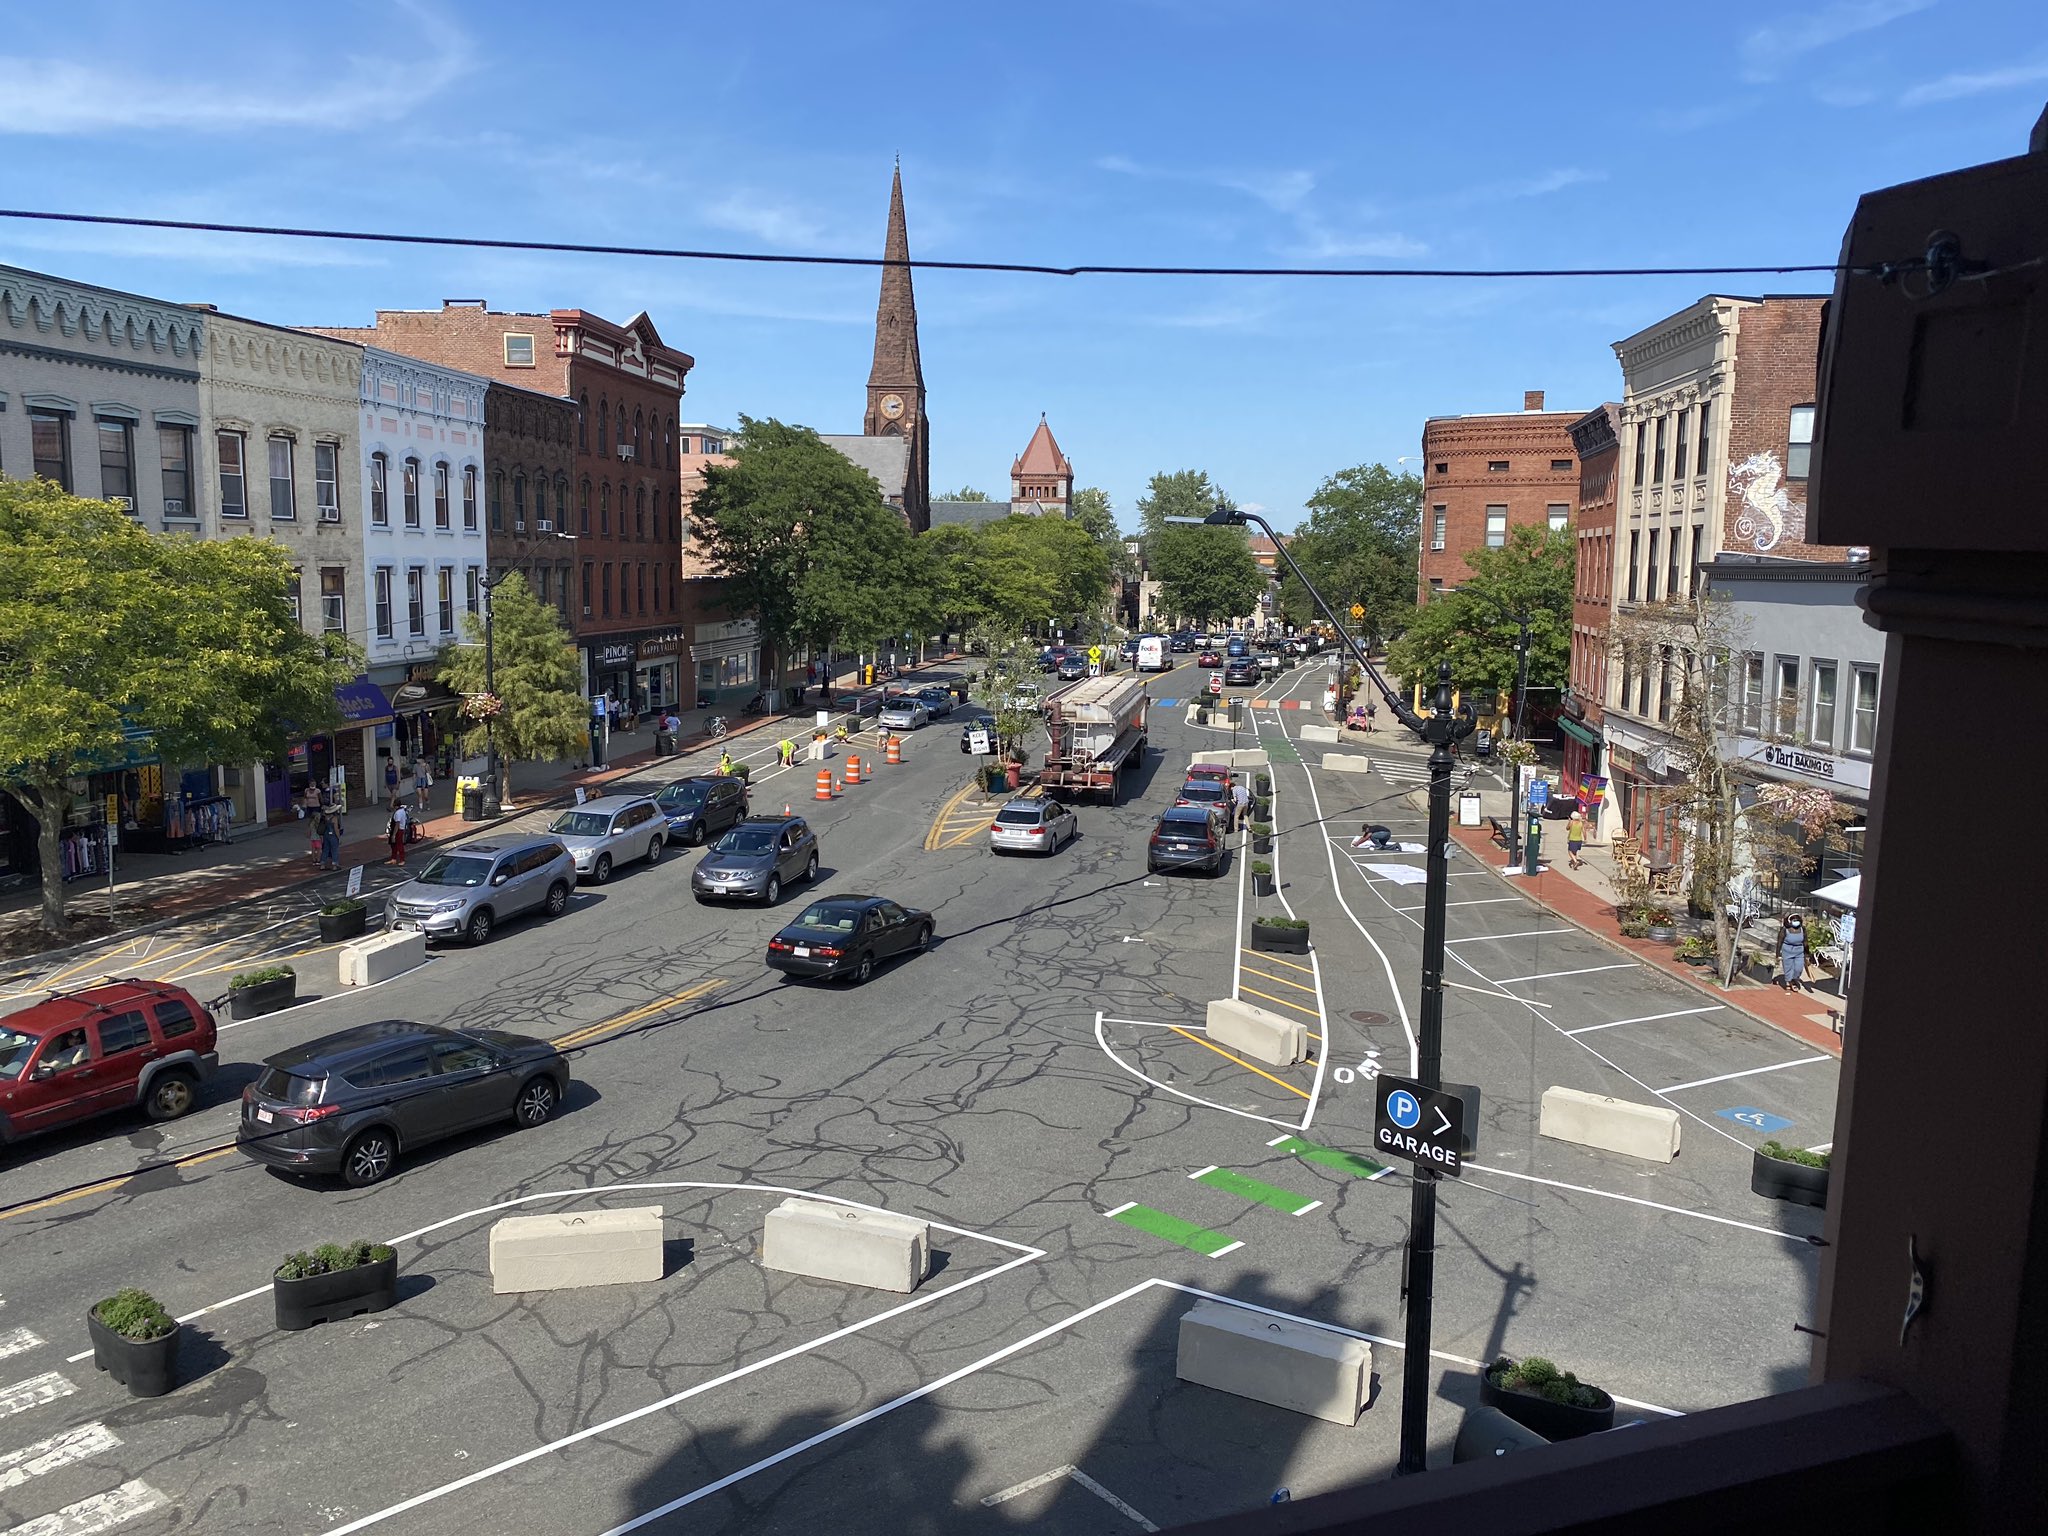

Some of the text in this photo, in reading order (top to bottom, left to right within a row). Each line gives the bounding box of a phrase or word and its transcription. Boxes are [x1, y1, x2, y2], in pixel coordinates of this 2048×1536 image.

[605, 645, 627, 659] PINCH
[643, 643, 678, 655] HAPPY VALLEY
[1775, 747, 1795, 768] Tart
[1795, 755, 1822, 772] BAKING
[1397, 1096, 1413, 1118] P
[1379, 1128, 1457, 1167] GARAGE
